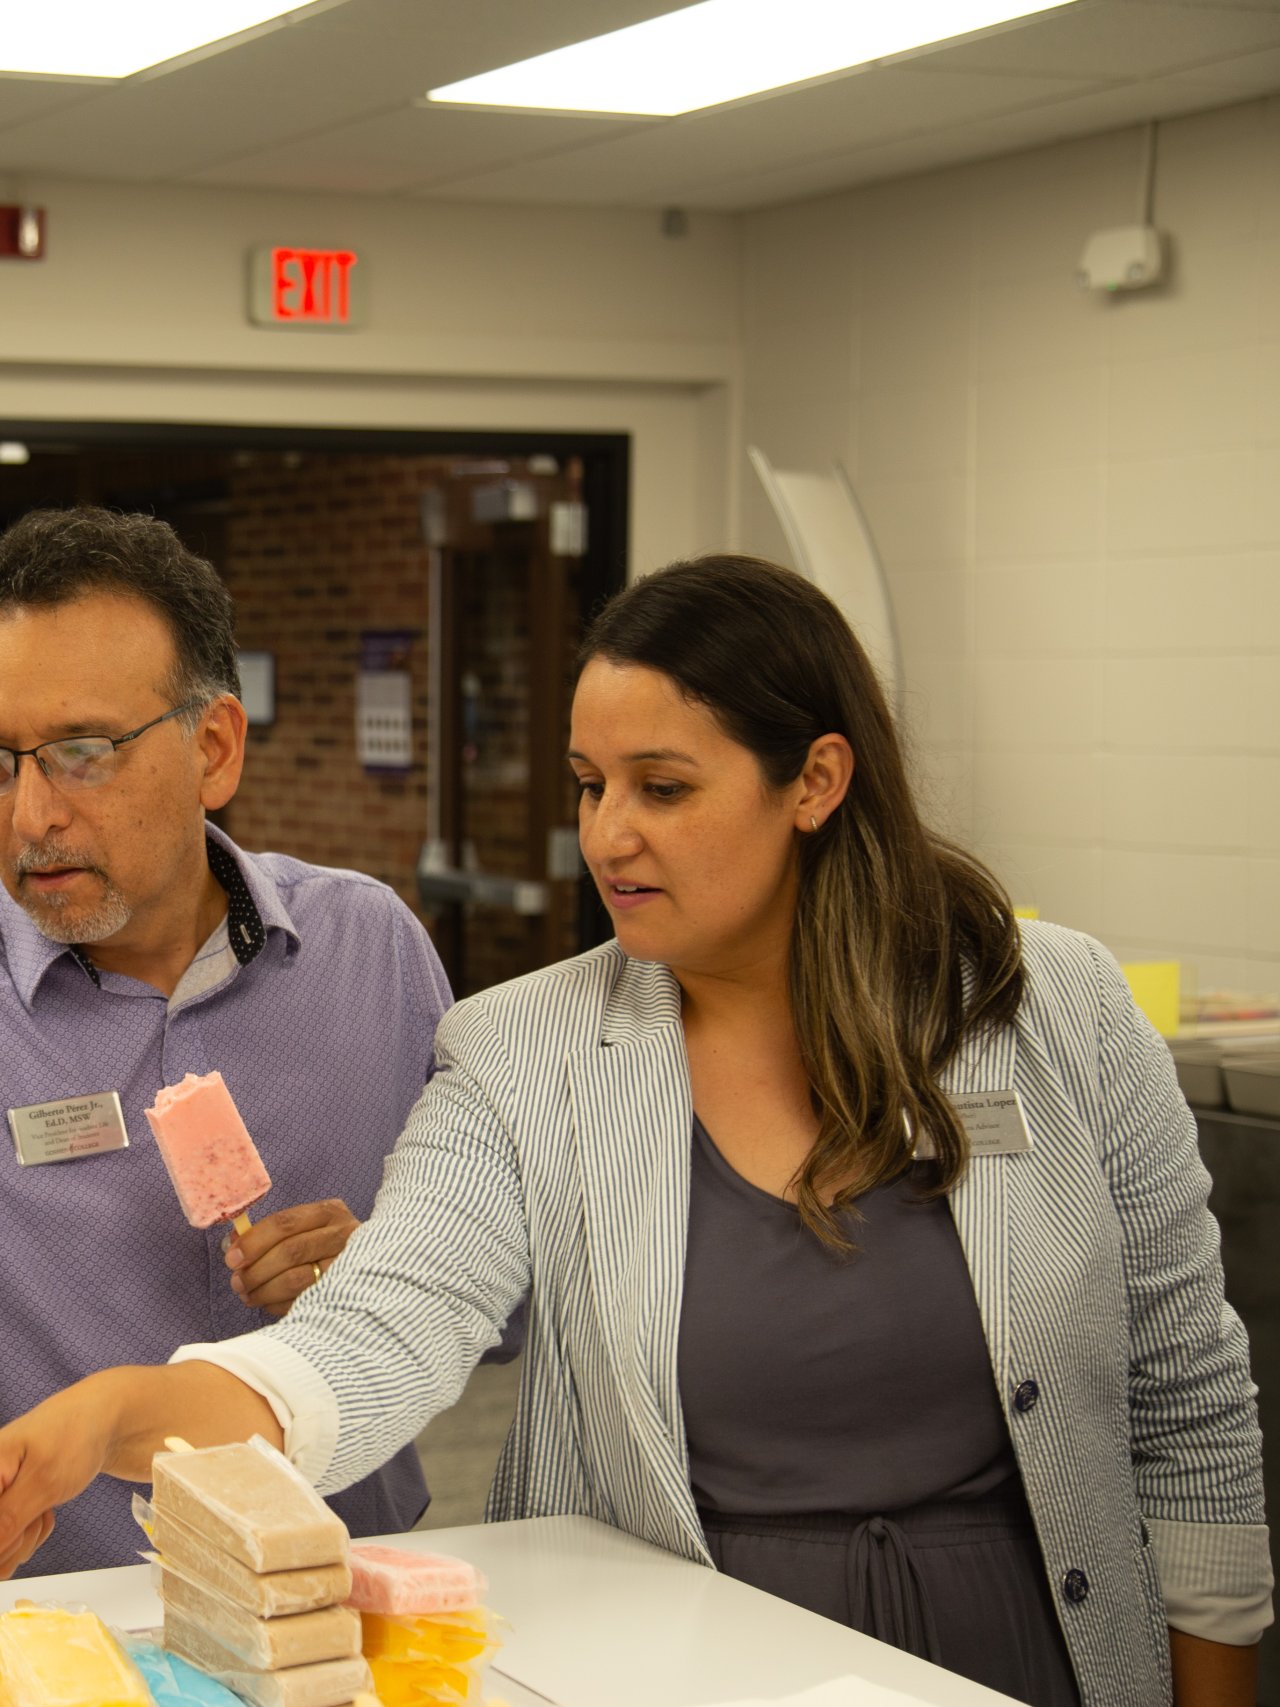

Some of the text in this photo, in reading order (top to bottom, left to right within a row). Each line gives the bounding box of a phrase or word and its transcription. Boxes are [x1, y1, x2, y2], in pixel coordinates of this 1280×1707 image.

[272, 247, 358, 325] EXIT
[952, 1098, 1016, 1110] autista Lopez
[28, 1108, 65, 1120] Gilberto
[69, 1112, 91, 1124] MSW
